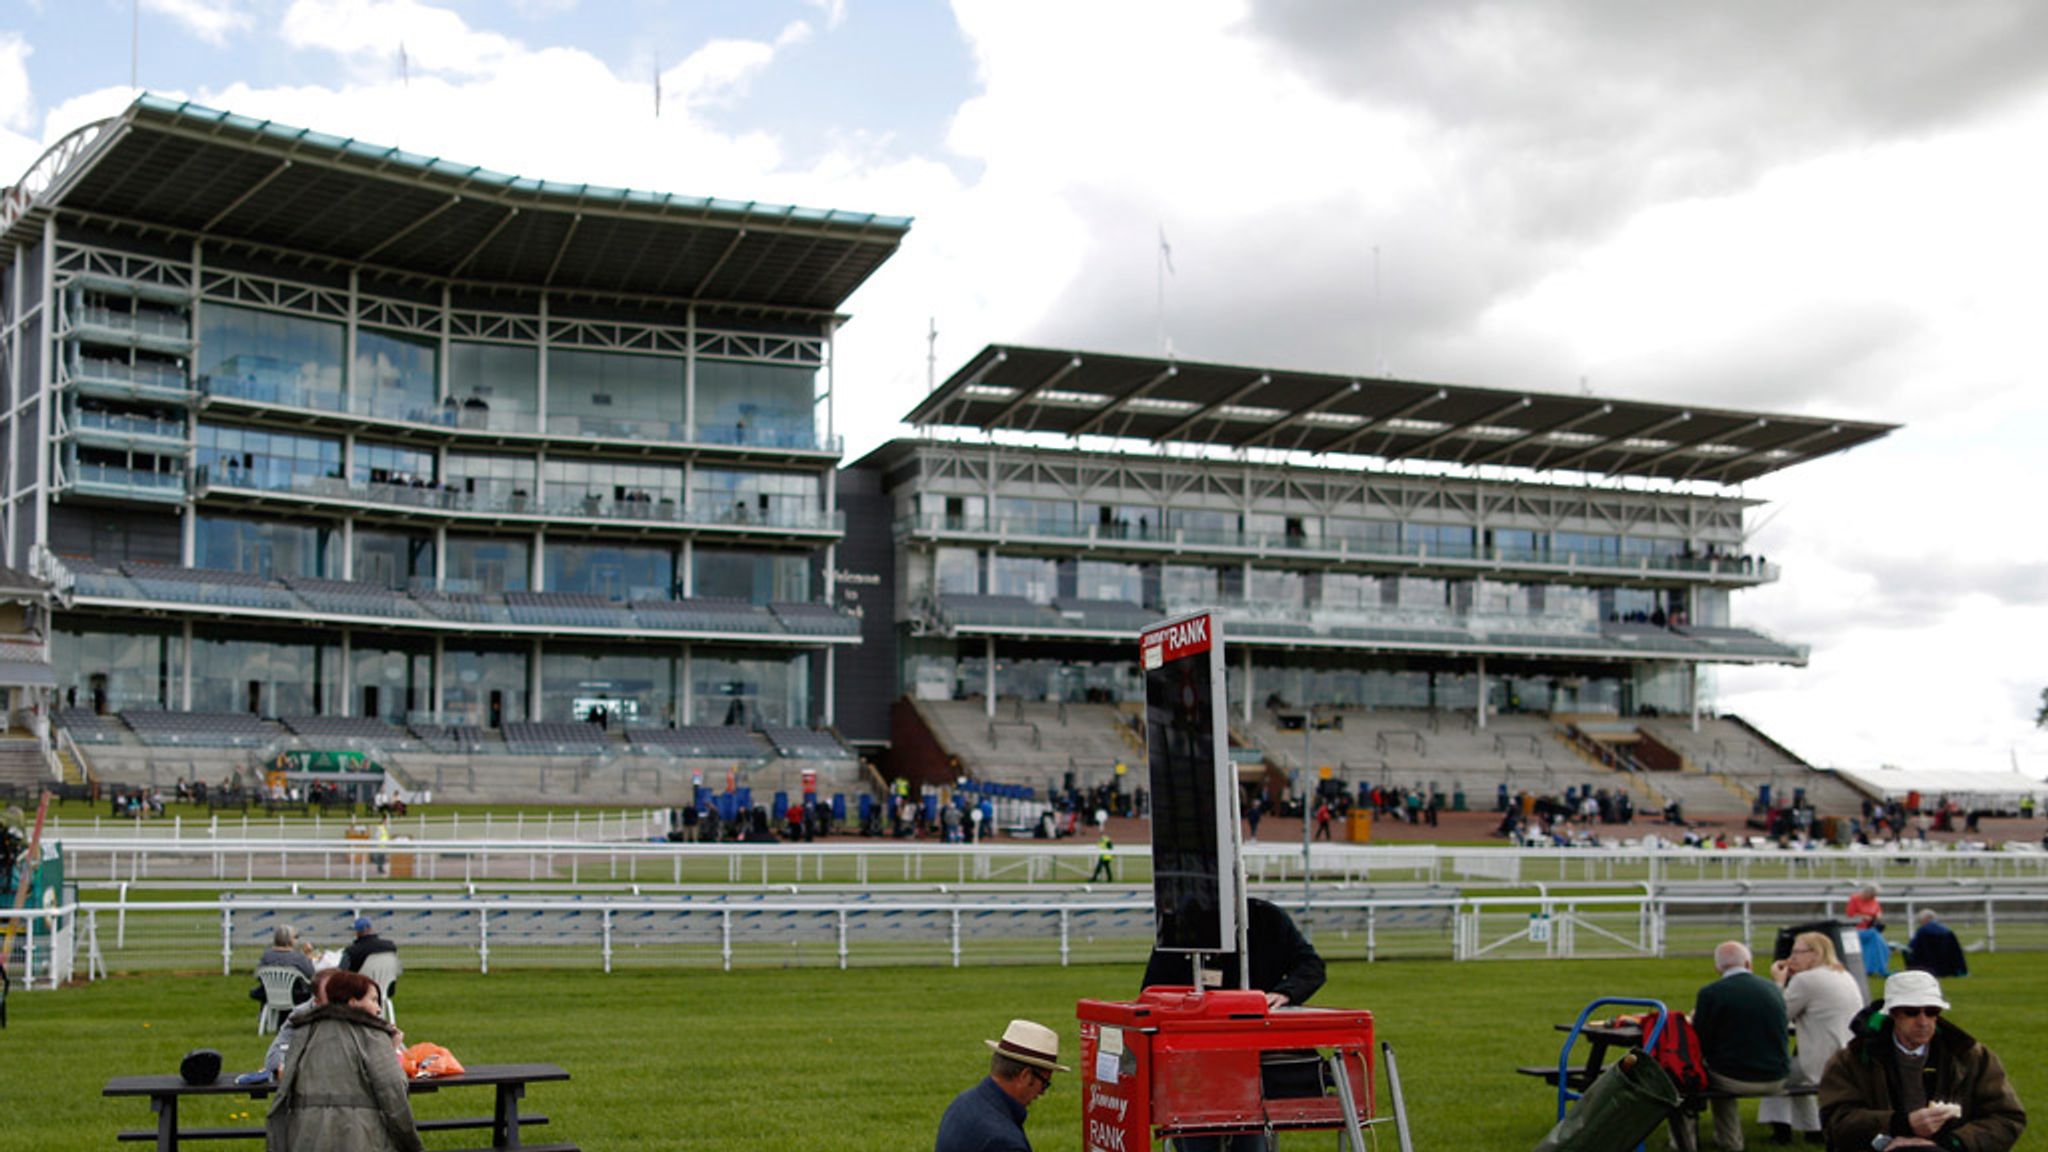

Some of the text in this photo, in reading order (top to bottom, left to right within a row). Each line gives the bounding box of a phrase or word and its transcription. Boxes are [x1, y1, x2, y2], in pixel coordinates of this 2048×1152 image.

[1169, 618, 1206, 650] RANK
[1088, 1083, 1128, 1123] Jimmy
[1089, 1119, 1126, 1152] RANK
